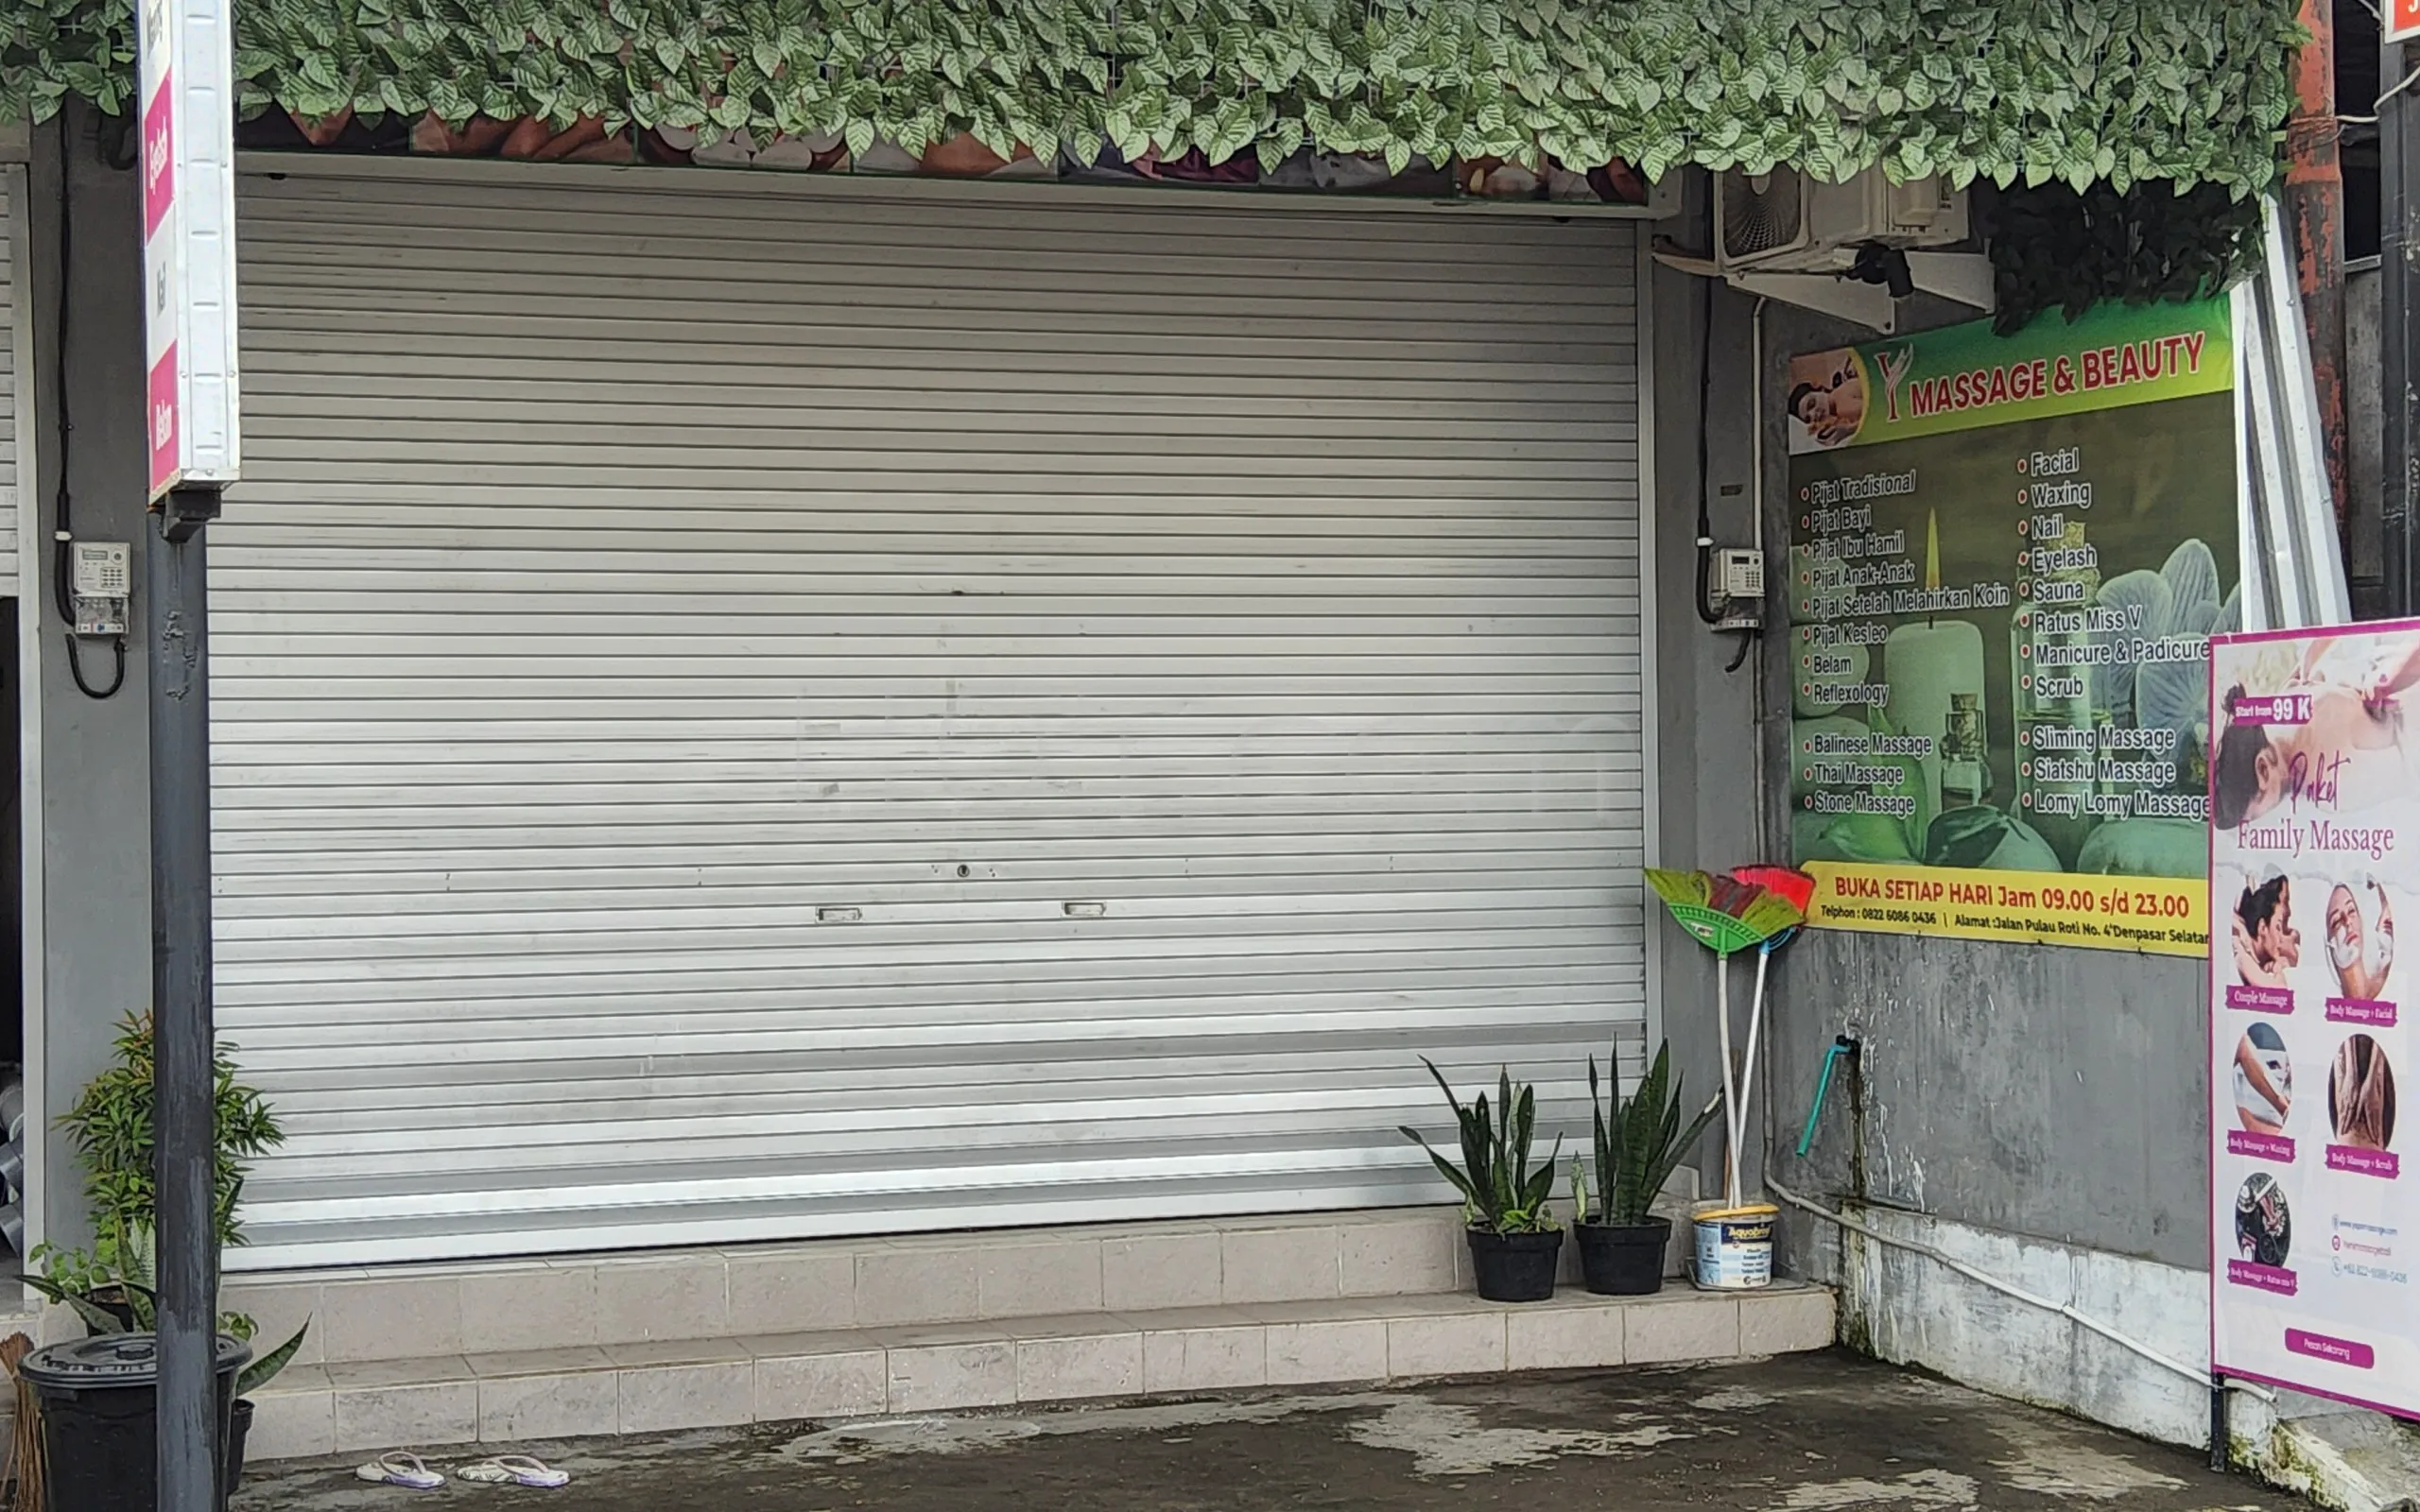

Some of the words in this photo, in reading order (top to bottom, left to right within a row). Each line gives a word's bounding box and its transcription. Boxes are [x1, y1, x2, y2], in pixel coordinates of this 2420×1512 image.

[1910, 358, 2048, 418] MASSAGE
[2053, 355, 2077, 395] &
[2083, 331, 2205, 390] BEAUTY
[2031, 448, 2079, 475] Facial
[1812, 481, 1840, 506] Pijat
[1842, 470, 1915, 499] Tradisional
[2032, 481, 2091, 507] Waxing
[1812, 511, 1840, 535] Pijat
[1842, 505, 1872, 533] Bayi
[2032, 514, 2063, 540] Nail
[1813, 539, 1840, 563] Pijat
[1842, 535, 1863, 558] Ibu
[1866, 530, 1904, 555] Hamil
[2033, 544, 2097, 576] Eyelash
[1813, 568, 1840, 591] Pijat
[1843, 559, 1914, 585] Anak-Anak
[1813, 598, 1841, 622] Pijat
[1843, 591, 1890, 615] Setelah
[1893, 587, 1970, 612] Melahirkan
[1974, 583, 2009, 606] Koin
[2033, 580, 2084, 602] Sauna
[2034, 612, 2081, 633] Ratus
[2086, 610, 2124, 630] Miss
[2130, 606, 2142, 628] V
[1813, 626, 1841, 649] Pijat
[1843, 623, 1887, 644] Kesleo
[2035, 644, 2110, 665] Manicure
[2116, 641, 2127, 662] &
[2134, 637, 2209, 661] Padicure
[1814, 683, 1889, 706] Reflexology
[2035, 675, 2083, 697] Scrub
[2273, 697, 2293, 722] 99
[2297, 696, 2311, 721] K
[1814, 734, 1868, 754] Balinese
[1872, 733, 1931, 758] Massage
[2033, 727, 2095, 752] Sliming
[2100, 726, 2174, 753] Massage
[1815, 764, 1842, 783] Thai
[1845, 764, 1903, 787] Massage
[2035, 759, 2094, 781] Siatshu
[2100, 759, 2175, 785] Massage
[1815, 793, 1853, 812] Stone
[1856, 793, 1914, 817] Massage
[2034, 789, 2079, 818] Lomy
[2083, 790, 2132, 819] Lomy
[2135, 790, 2210, 819] Massage
[2238, 818, 2305, 859] Family
[2309, 820, 2394, 861] Massage
[1835, 877, 1881, 899] BUKA
[1885, 879, 1944, 902] SETIAP
[1949, 883, 1993, 906] HARI
[1997, 885, 2036, 909] Jam
[2041, 887, 2094, 912] 09.00
[2100, 888, 2130, 915] s/d
[2135, 893, 2189, 919] 23.00
[1821, 904, 1856, 920] Telphon
[1861, 908, 1884, 920] 0822
[1911, 913, 1936, 924] 0436
[1955, 914, 1991, 928] Alamat
[2025, 919, 2056, 933] Pulau
[2058, 920, 2080, 935] Roti
[2082, 922, 2100, 936] No.
[2234, 989, 2258, 1005] Couple
[2258, 991, 2288, 1008] Massage
[2345, 1005, 2370, 1020] Massage
